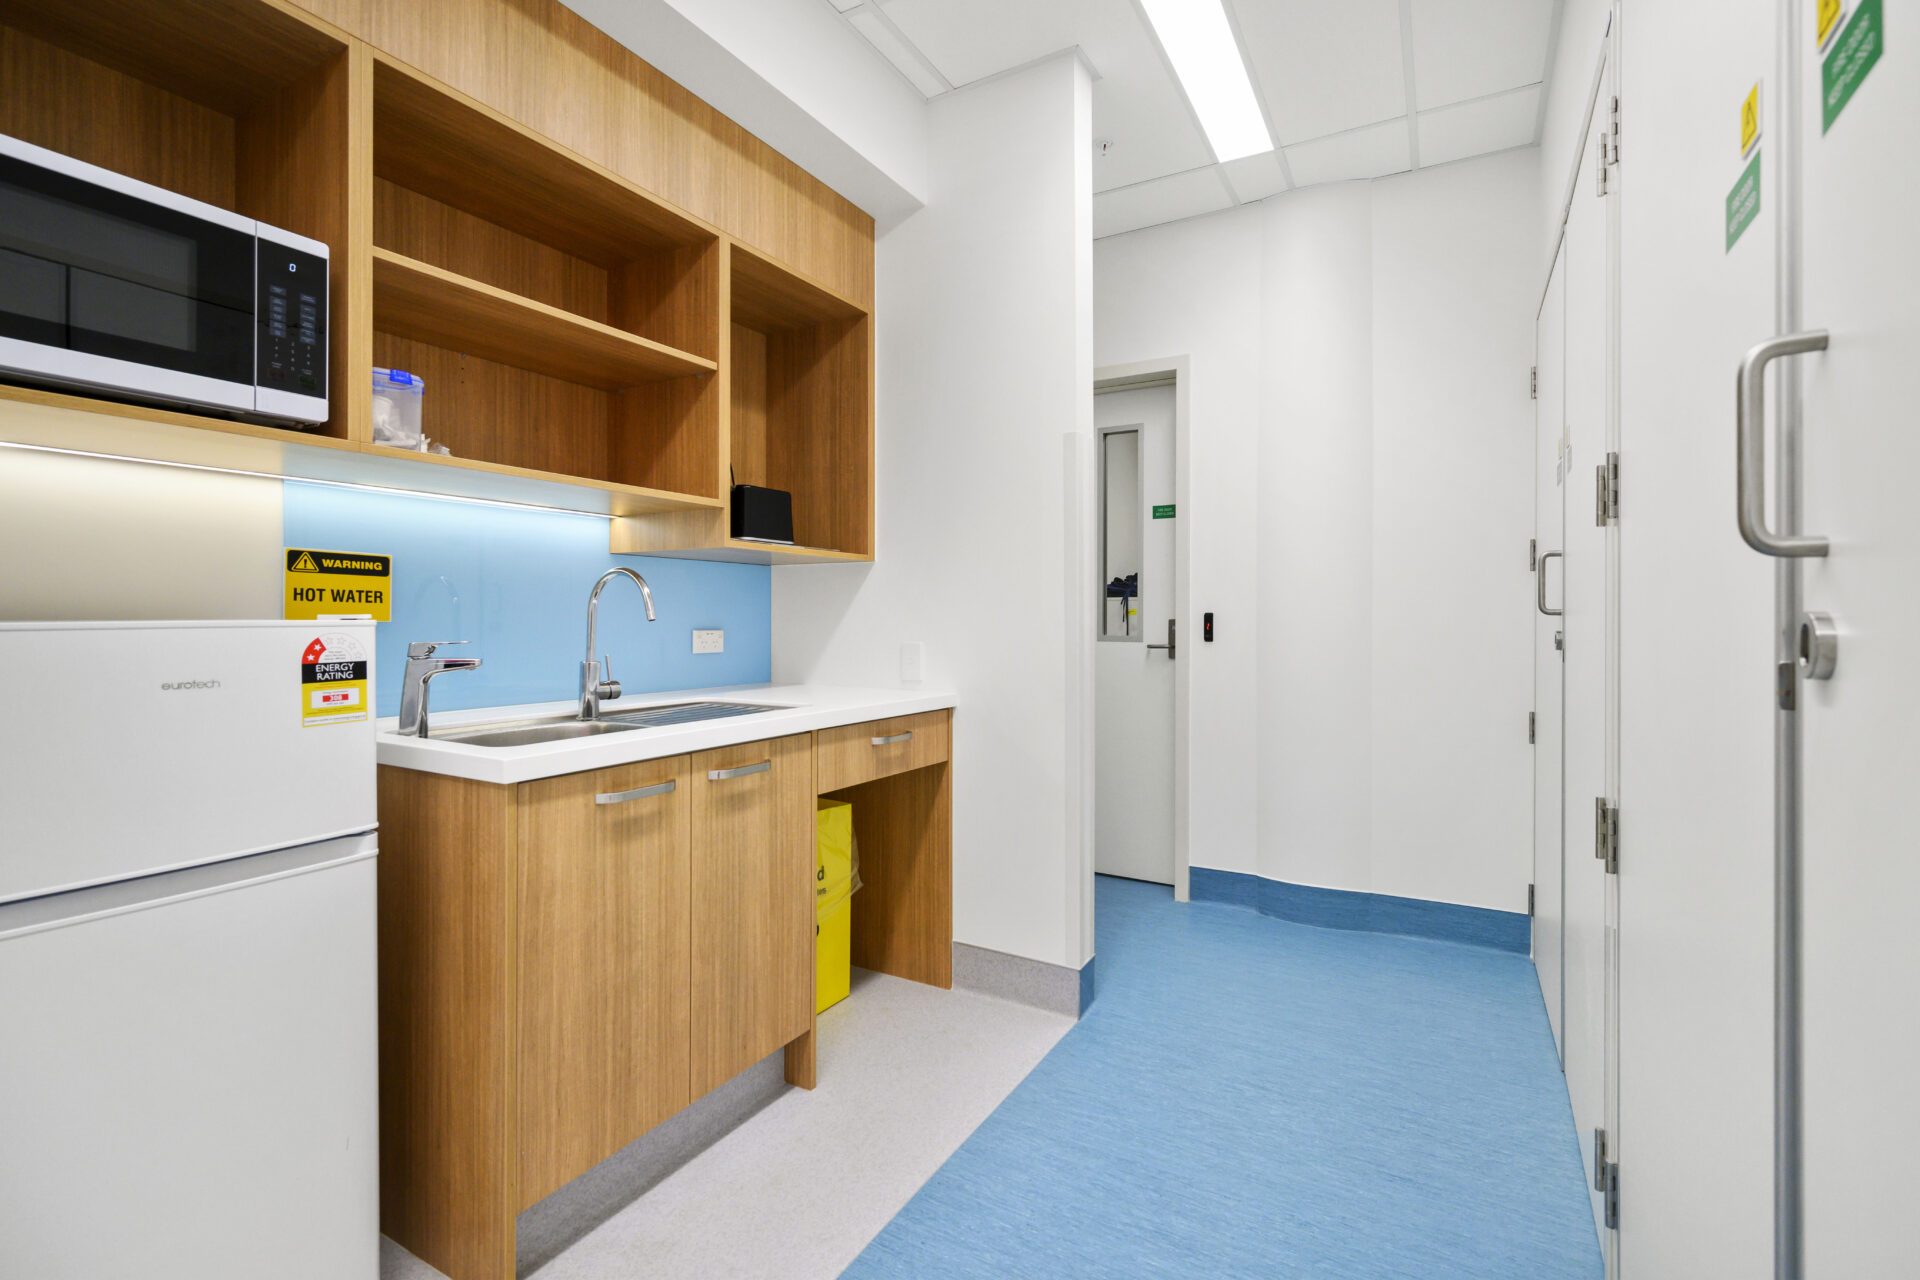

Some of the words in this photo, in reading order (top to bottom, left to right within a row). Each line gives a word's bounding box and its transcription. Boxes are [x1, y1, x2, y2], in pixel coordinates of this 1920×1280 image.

[322, 558, 383, 571] WARNING
[293, 587, 326, 602] HOT
[330, 589, 384, 604] WATER
[315, 662, 355, 673] ENERGY
[316, 671, 354, 681] RATING
[161, 679, 221, 691] eurotech
